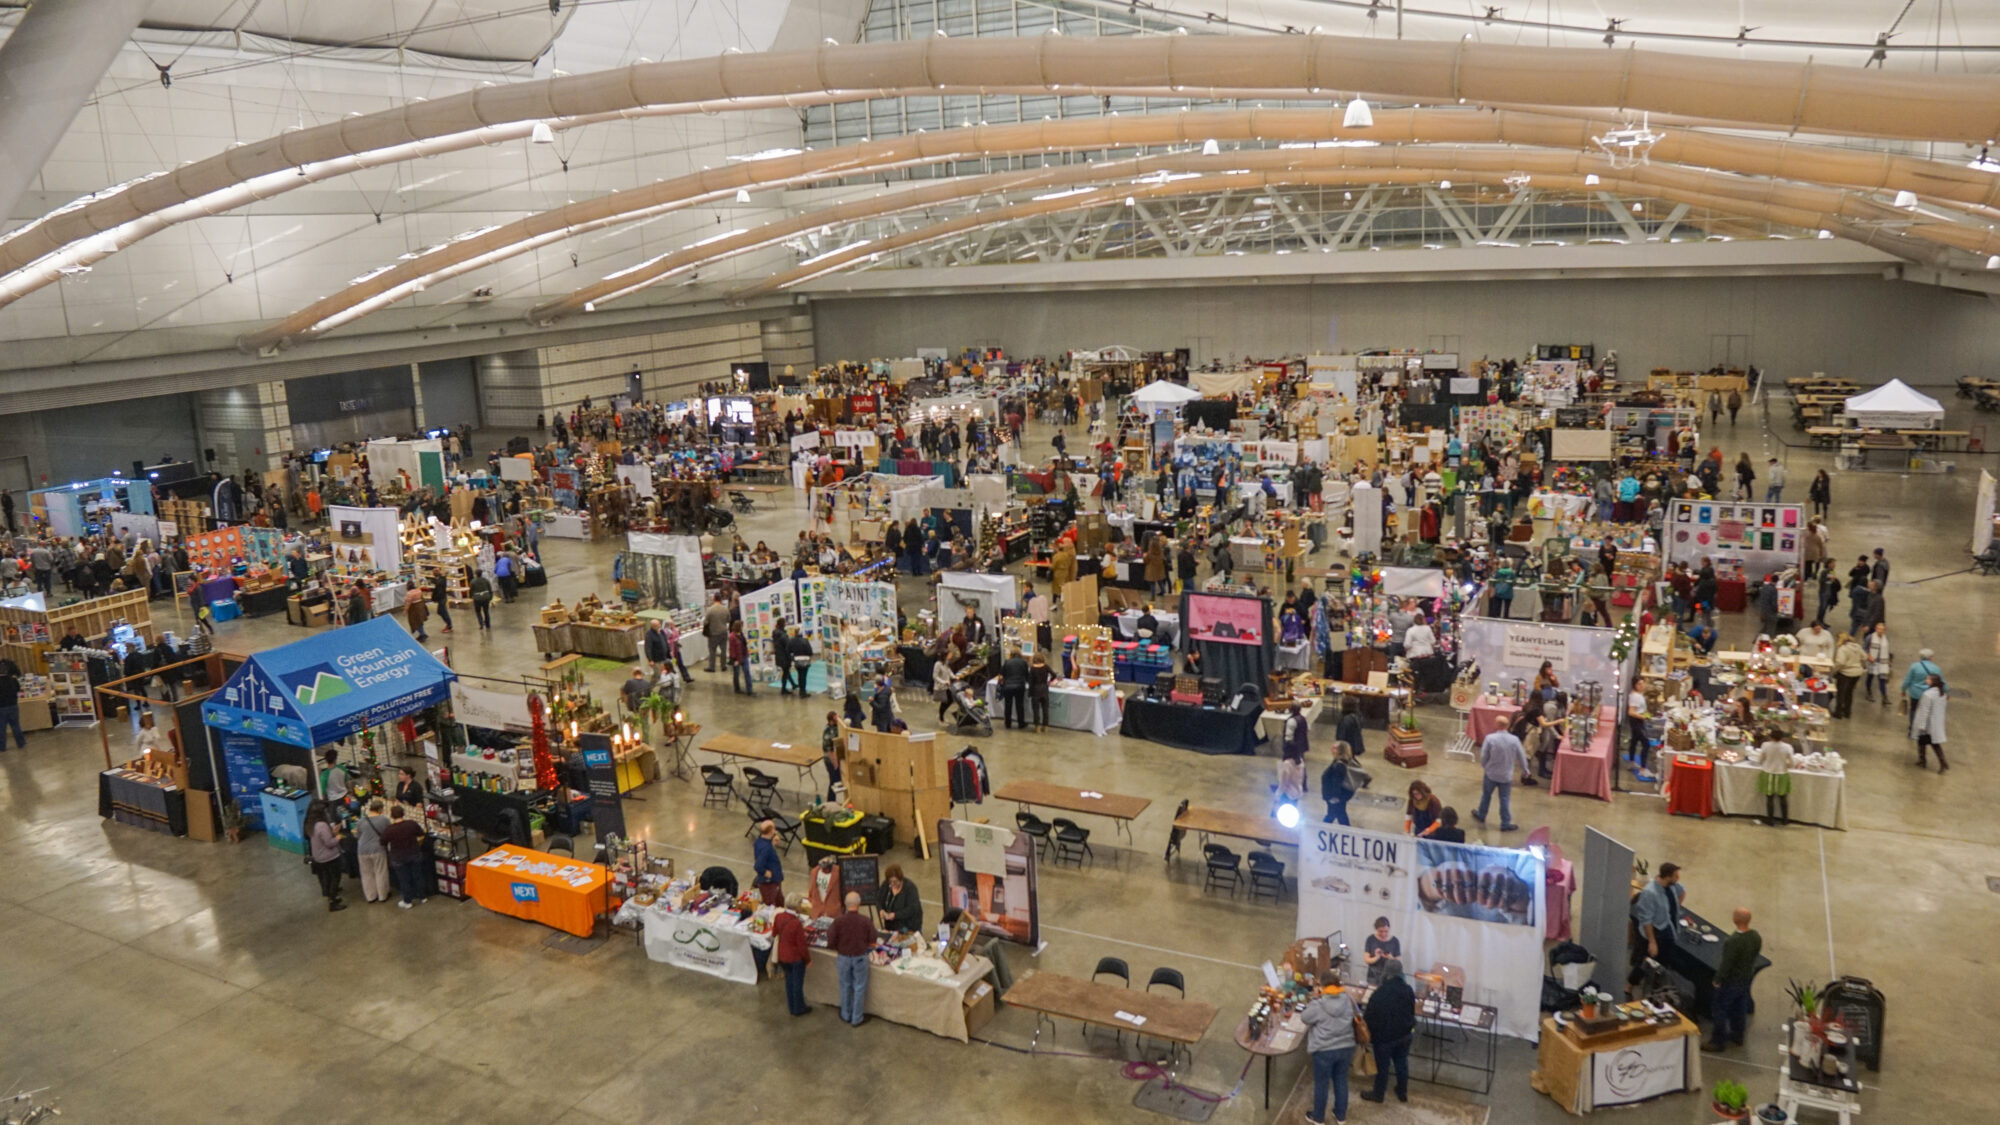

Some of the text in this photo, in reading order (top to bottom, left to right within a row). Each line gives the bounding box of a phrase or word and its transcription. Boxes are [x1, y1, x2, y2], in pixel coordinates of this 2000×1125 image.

[837, 585, 870, 602] PAINT
[850, 603, 861, 615] BY
[1509, 634, 1565, 647] YEAHYELHSA
[336, 647, 385, 667] Green
[344, 648, 417, 678] Mountain
[354, 664, 411, 688] Energy
[337, 687, 434, 728] CHOOSE POLLUTION FREE
[351, 710, 398, 733] ELCTRICITY
[586, 752, 608, 762] NEXT
[1317, 829, 1397, 864] SKELTON
[513, 886, 536, 898] NEXT
